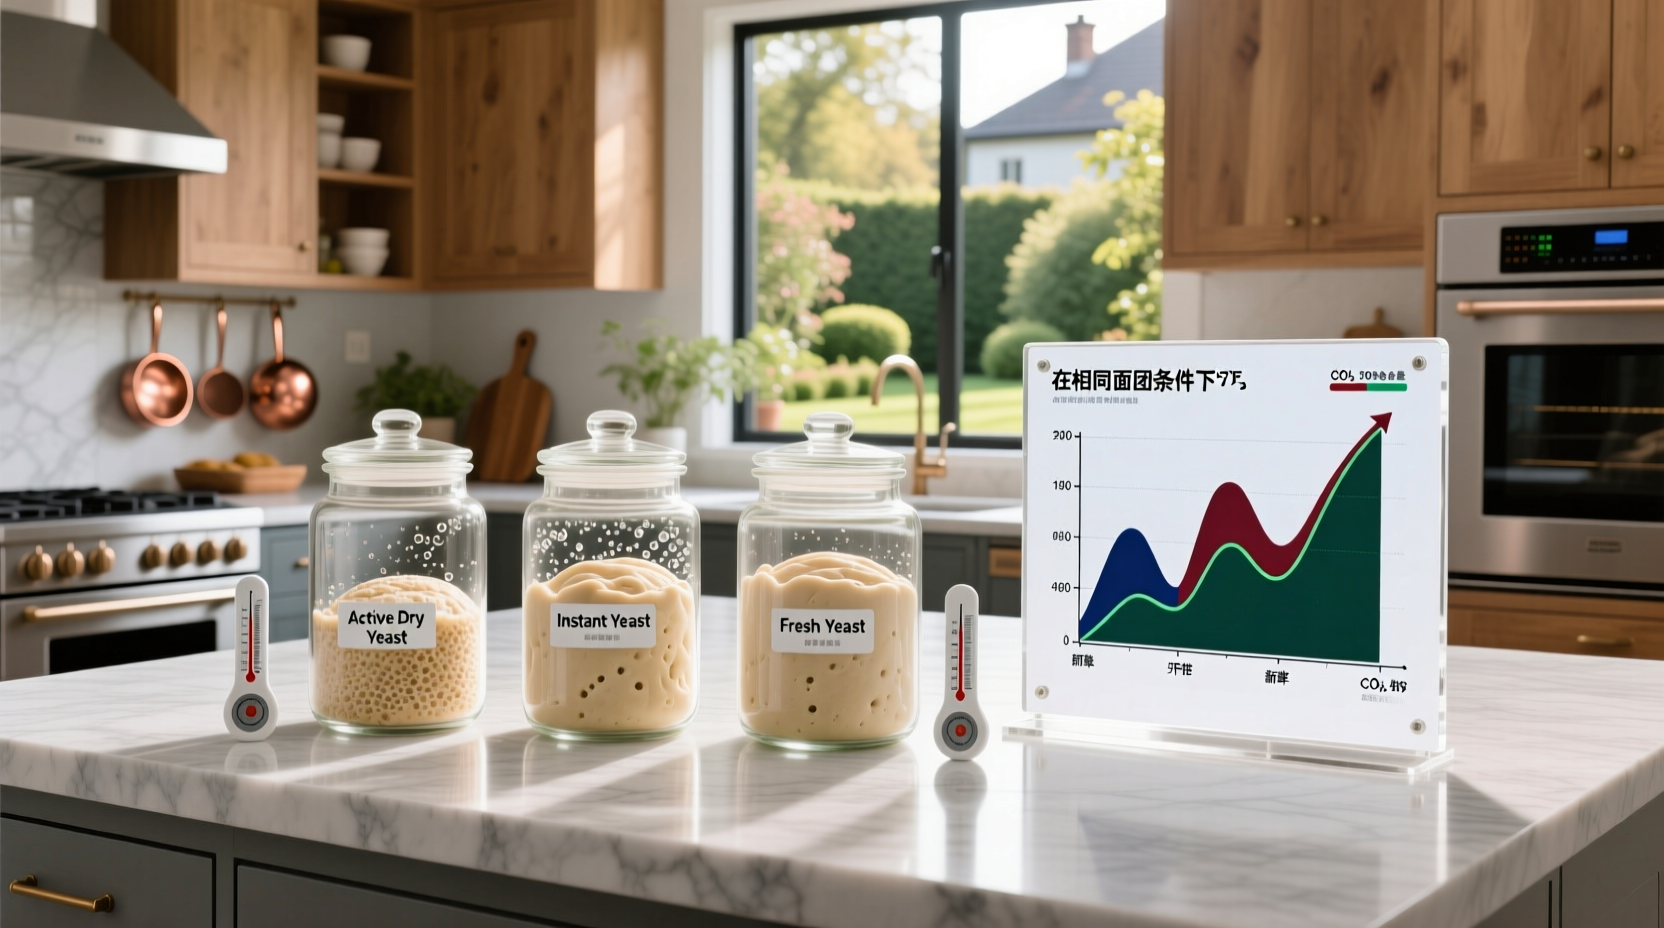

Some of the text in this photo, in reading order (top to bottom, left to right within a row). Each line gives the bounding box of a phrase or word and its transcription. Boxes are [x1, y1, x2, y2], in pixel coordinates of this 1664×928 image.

[1053, 430, 1073, 441] 200
[348, 609, 425, 629] Active Dry
[557, 613, 651, 628] Instant Yeast
[780, 617, 866, 634] Fresh Yeast
[366, 629, 408, 645] Yeast
[1063, 634, 1070, 646] 0
